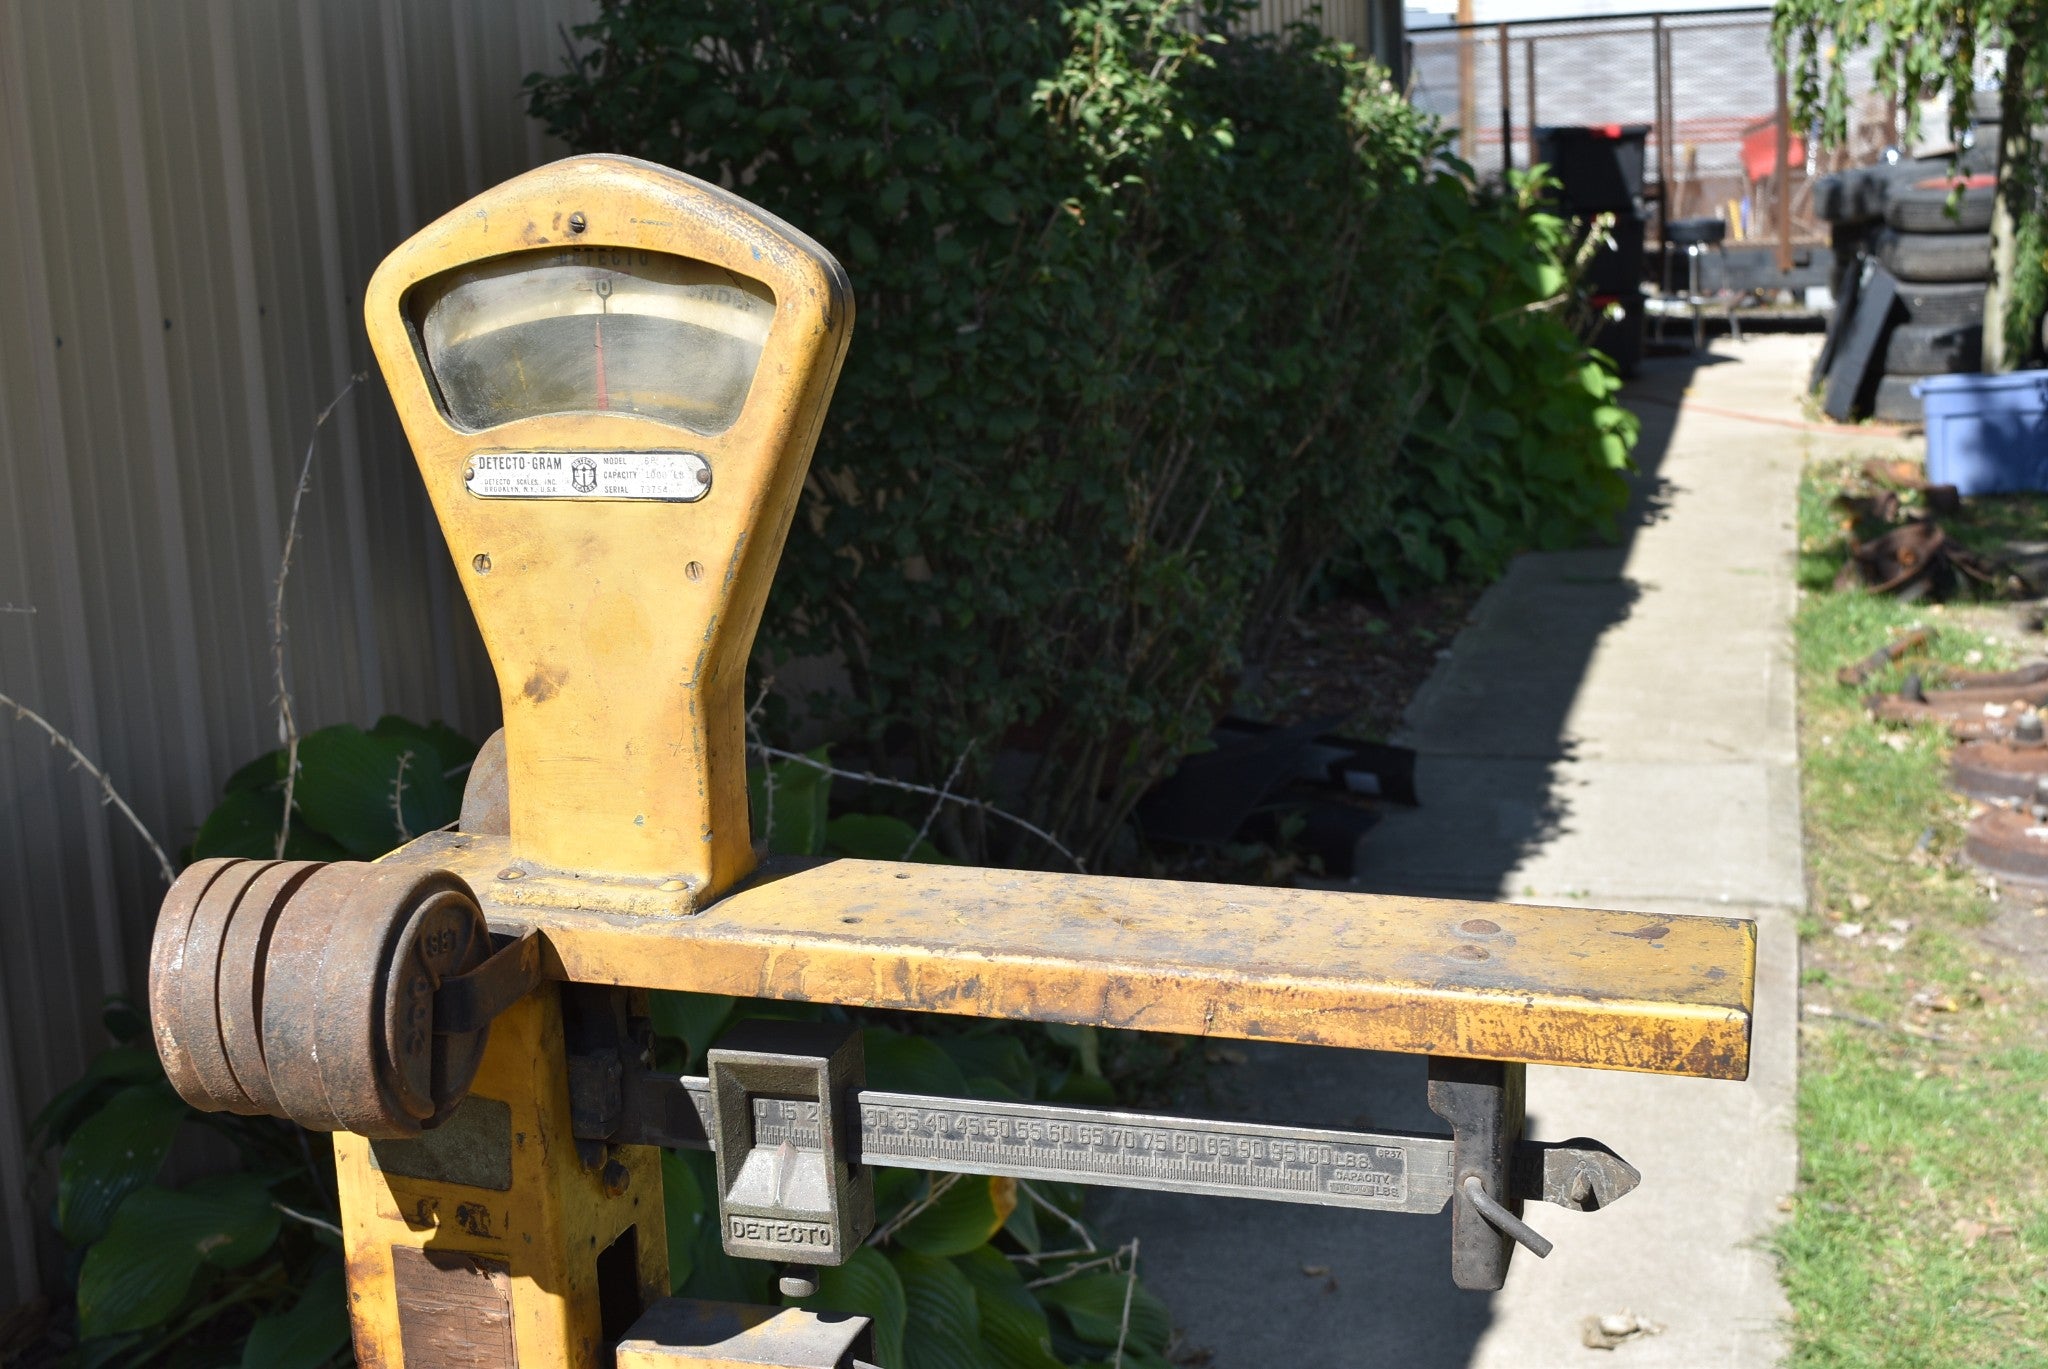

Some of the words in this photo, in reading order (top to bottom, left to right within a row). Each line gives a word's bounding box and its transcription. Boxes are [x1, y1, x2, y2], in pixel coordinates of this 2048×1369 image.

[603, 457, 627, 465] MODEL
[603, 471, 638, 479] CAPACITY
[484, 478, 511, 486] DETECTO
[604, 485, 629, 494] SERIAL
[780, 1101, 798, 1120] 15
[865, 1108, 889, 1128] 30
[895, 1110, 920, 1131] 35
[924, 1113, 950, 1134] 40
[955, 1116, 981, 1136] 45
[986, 1118, 1011, 1139] 50
[1015, 1120, 1042, 1141] 55
[1048, 1123, 1073, 1144] 60
[1079, 1126, 1104, 1147] 65
[1110, 1128, 1135, 1149] 70
[1143, 1131, 1167, 1153] 75
[1173, 1134, 1199, 1155] 80
[1205, 1136, 1231, 1157] 85
[1238, 1139, 1263, 1160] 90
[1270, 1141, 1297, 1163] 95
[1299, 1143, 1331, 1166] 100
[1335, 1170, 1390, 1185] CAPACITY
[732, 1220, 831, 1246] DETECTO
